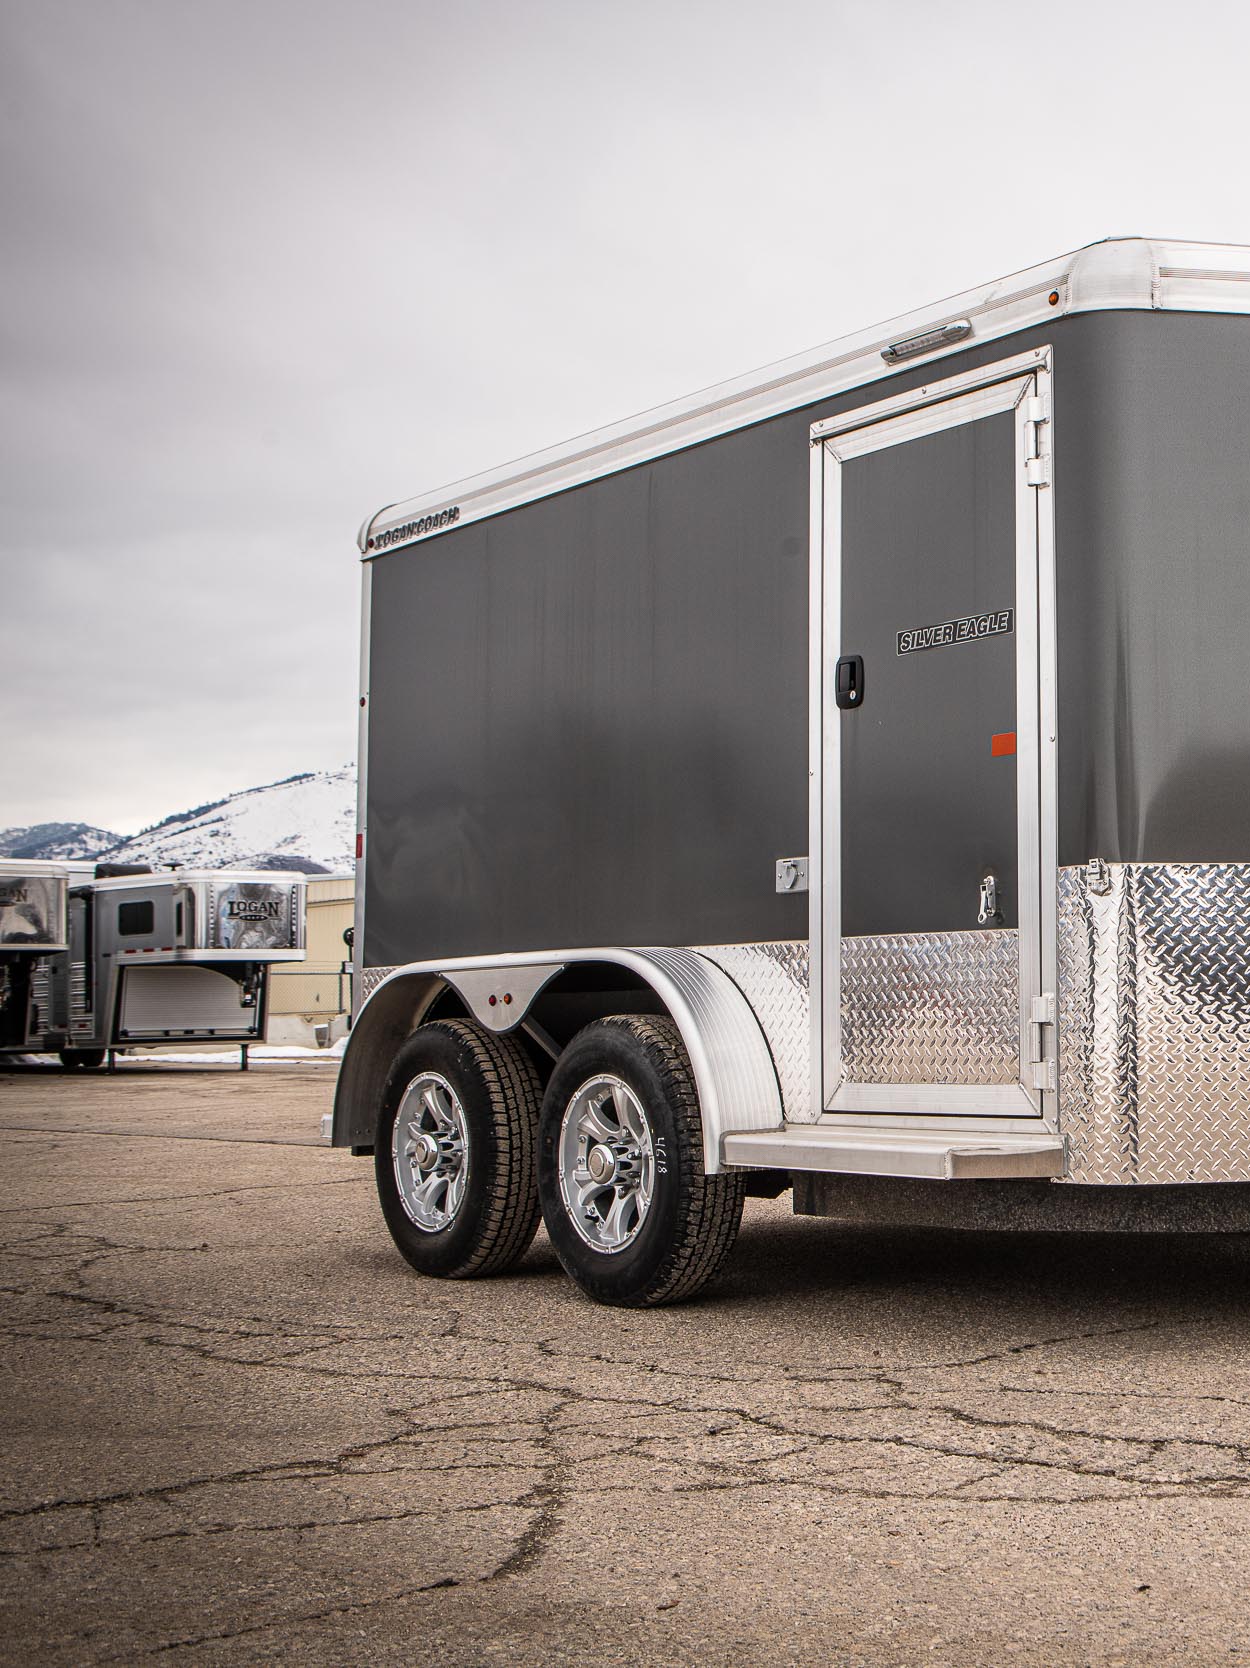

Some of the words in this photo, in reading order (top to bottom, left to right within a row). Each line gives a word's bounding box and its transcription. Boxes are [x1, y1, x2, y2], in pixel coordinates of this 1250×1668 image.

[374, 522, 414, 550] LOGAN
[416, 506, 460, 534] COACH
[900, 624, 953, 652] SILVER
[956, 612, 1009, 641] EAGLE
[0, 887, 28, 903] GAN
[228, 901, 280, 916] LOGAN
